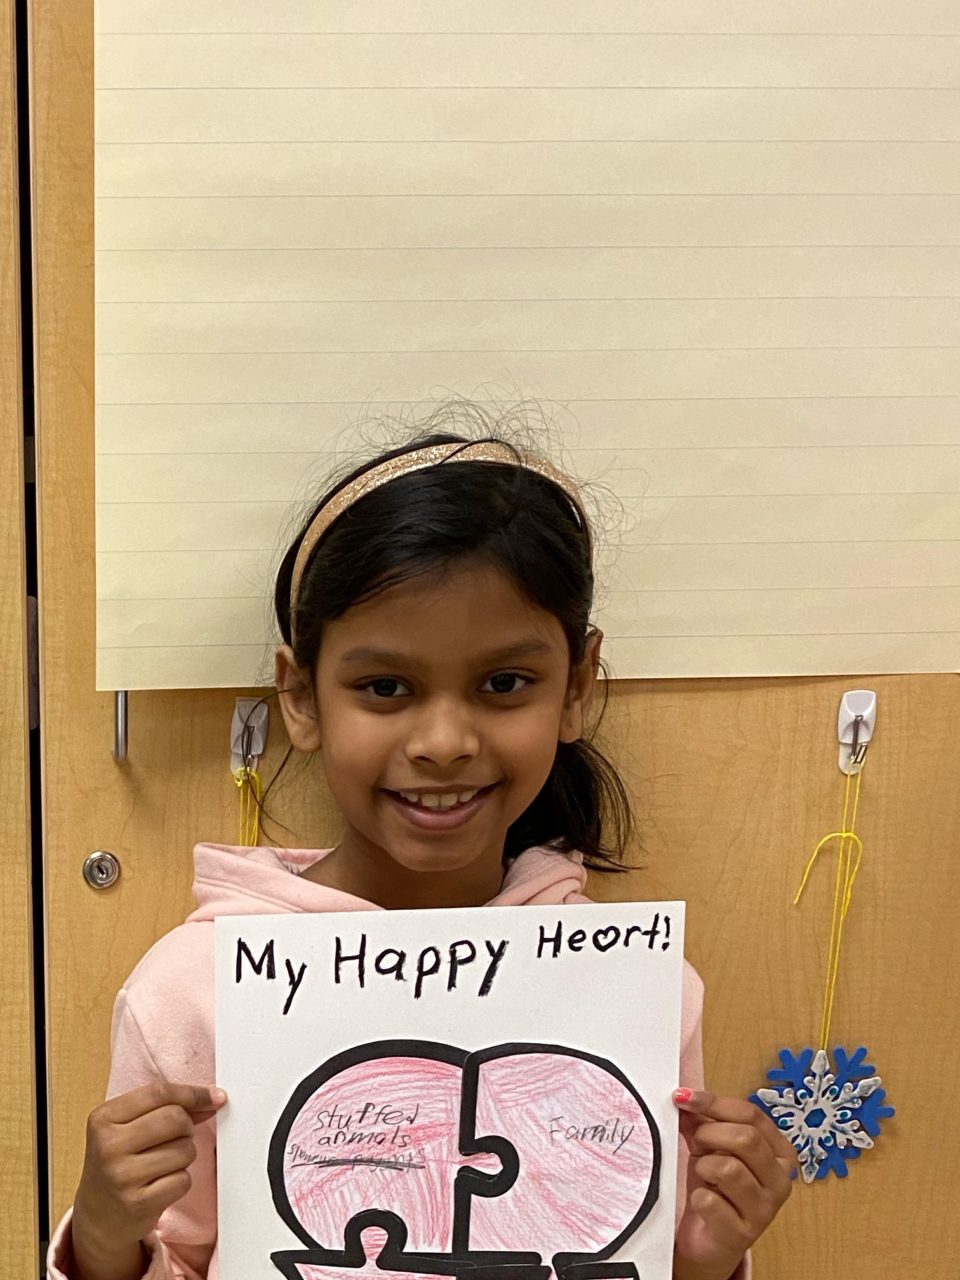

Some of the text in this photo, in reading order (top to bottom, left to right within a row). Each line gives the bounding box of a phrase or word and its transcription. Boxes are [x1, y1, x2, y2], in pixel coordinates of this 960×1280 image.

[234, 937, 307, 1015] My
[334, 933, 510, 999] Happy
[548, 1115, 635, 1156] Family
